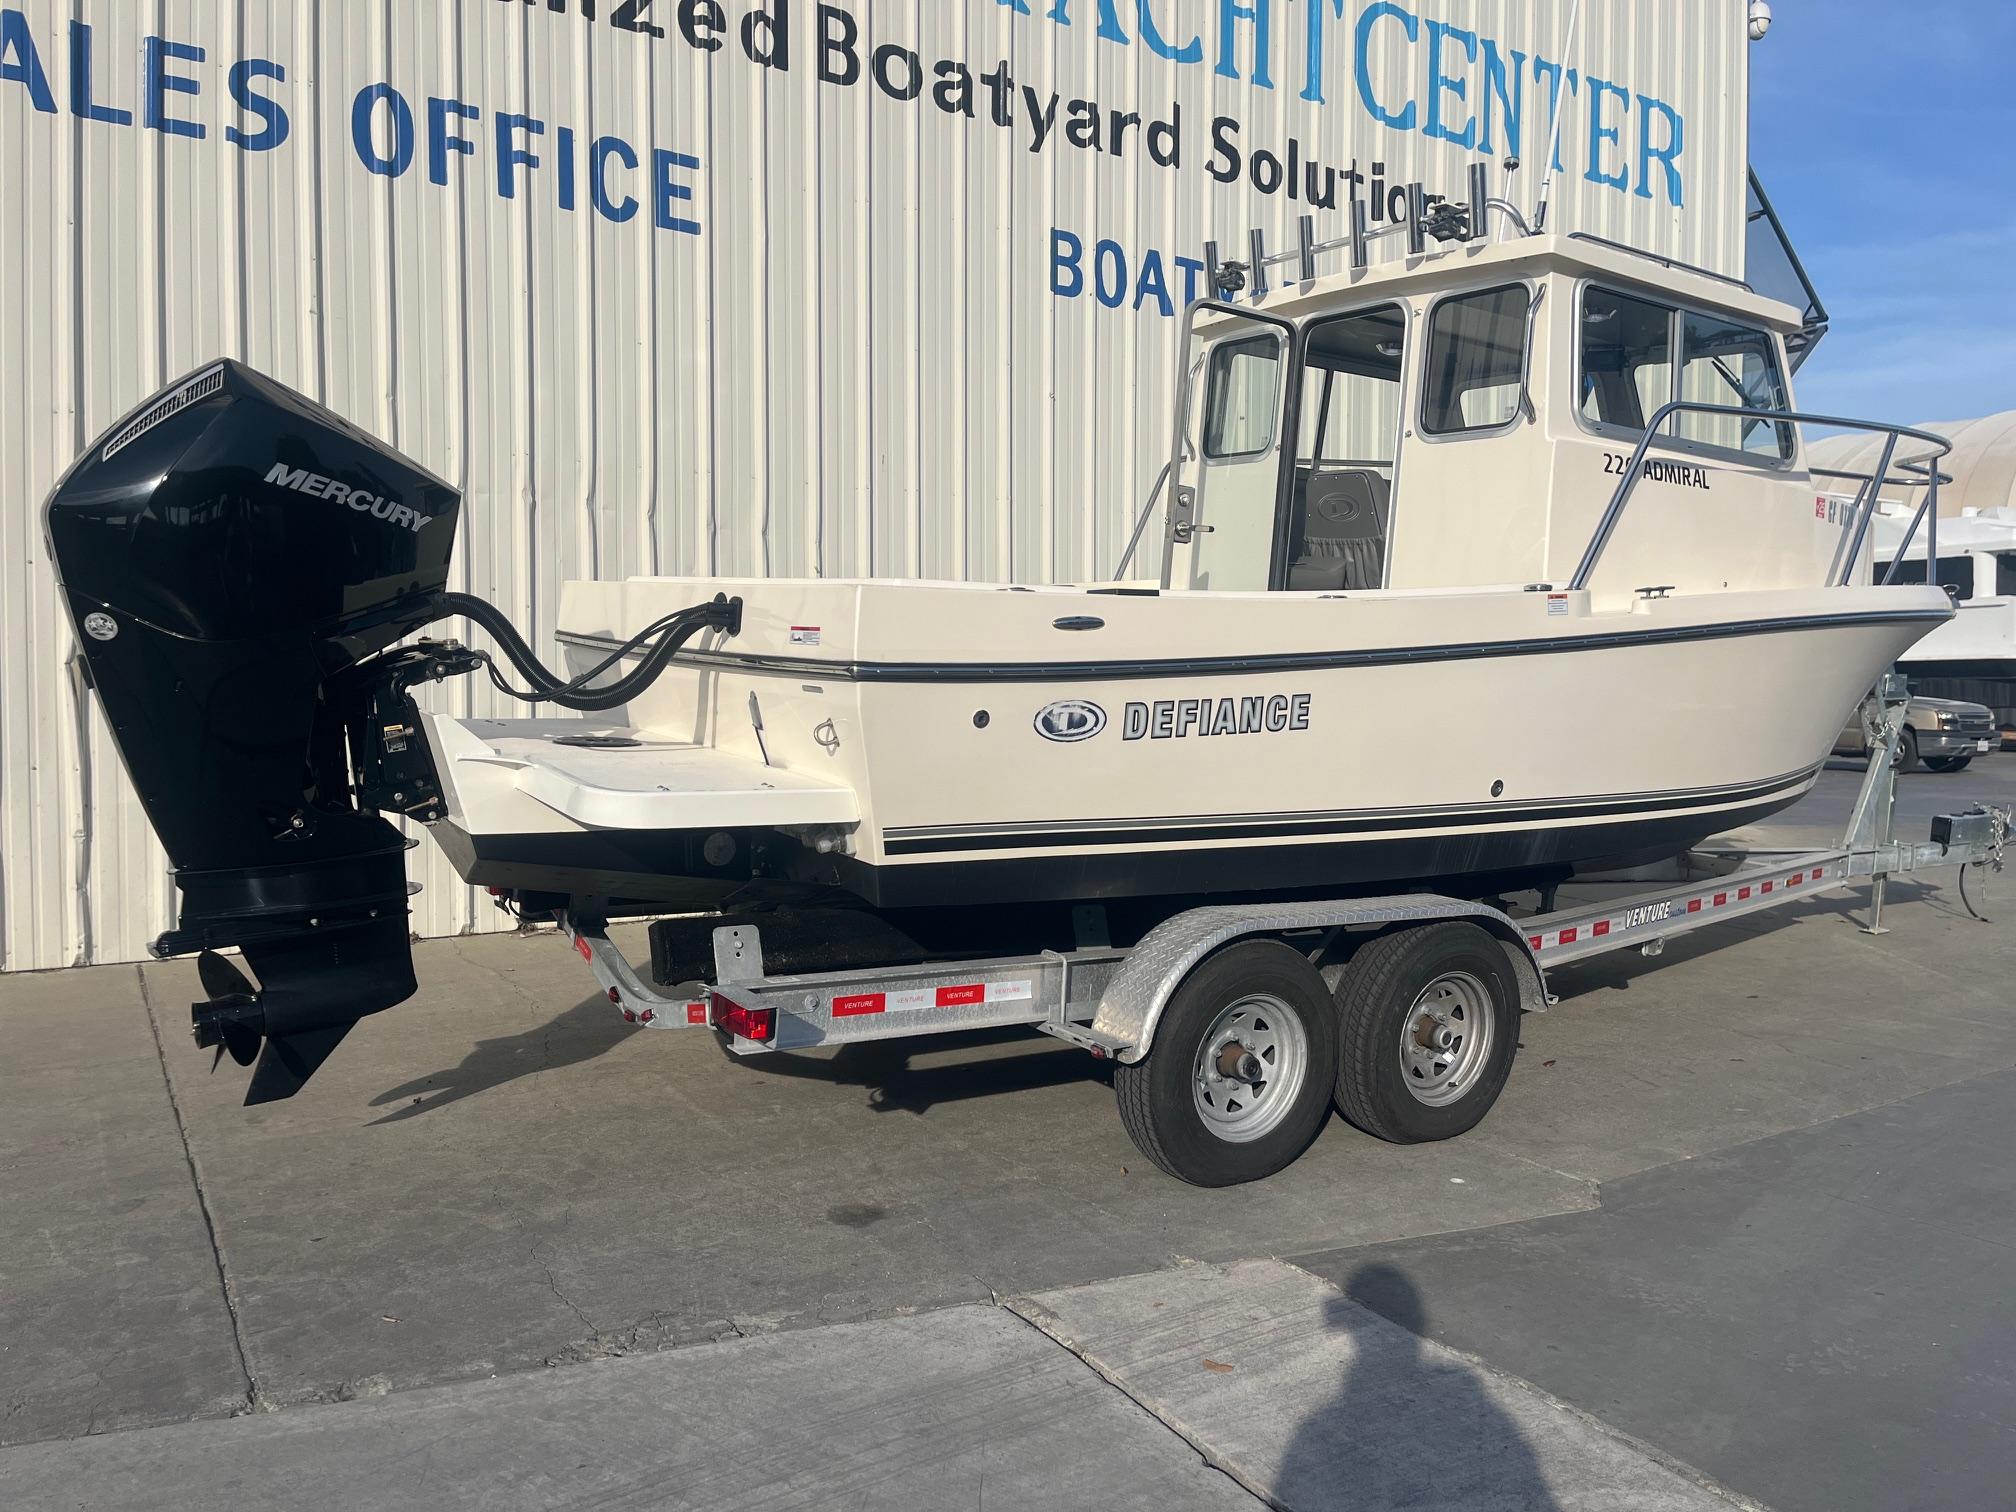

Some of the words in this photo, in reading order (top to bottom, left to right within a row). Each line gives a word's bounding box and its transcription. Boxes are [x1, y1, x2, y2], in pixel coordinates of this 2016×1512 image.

[817, 3, 1181, 169] Boatyard
[1354, 2, 1684, 209] CENTER
[351, 82, 701, 235] OFFICE
[263, 462, 433, 533] MERCURY
[1643, 460, 1710, 489] ADMIRAL
[1122, 693, 1312, 741] DEFIANCE
[1624, 899, 1672, 930] VENTURE
[844, 1000, 873, 1009] VENTURE
[896, 995, 925, 1004] VENTURE
[946, 990, 974, 999] VENTURE
[994, 986, 1021, 995] VENTURE
